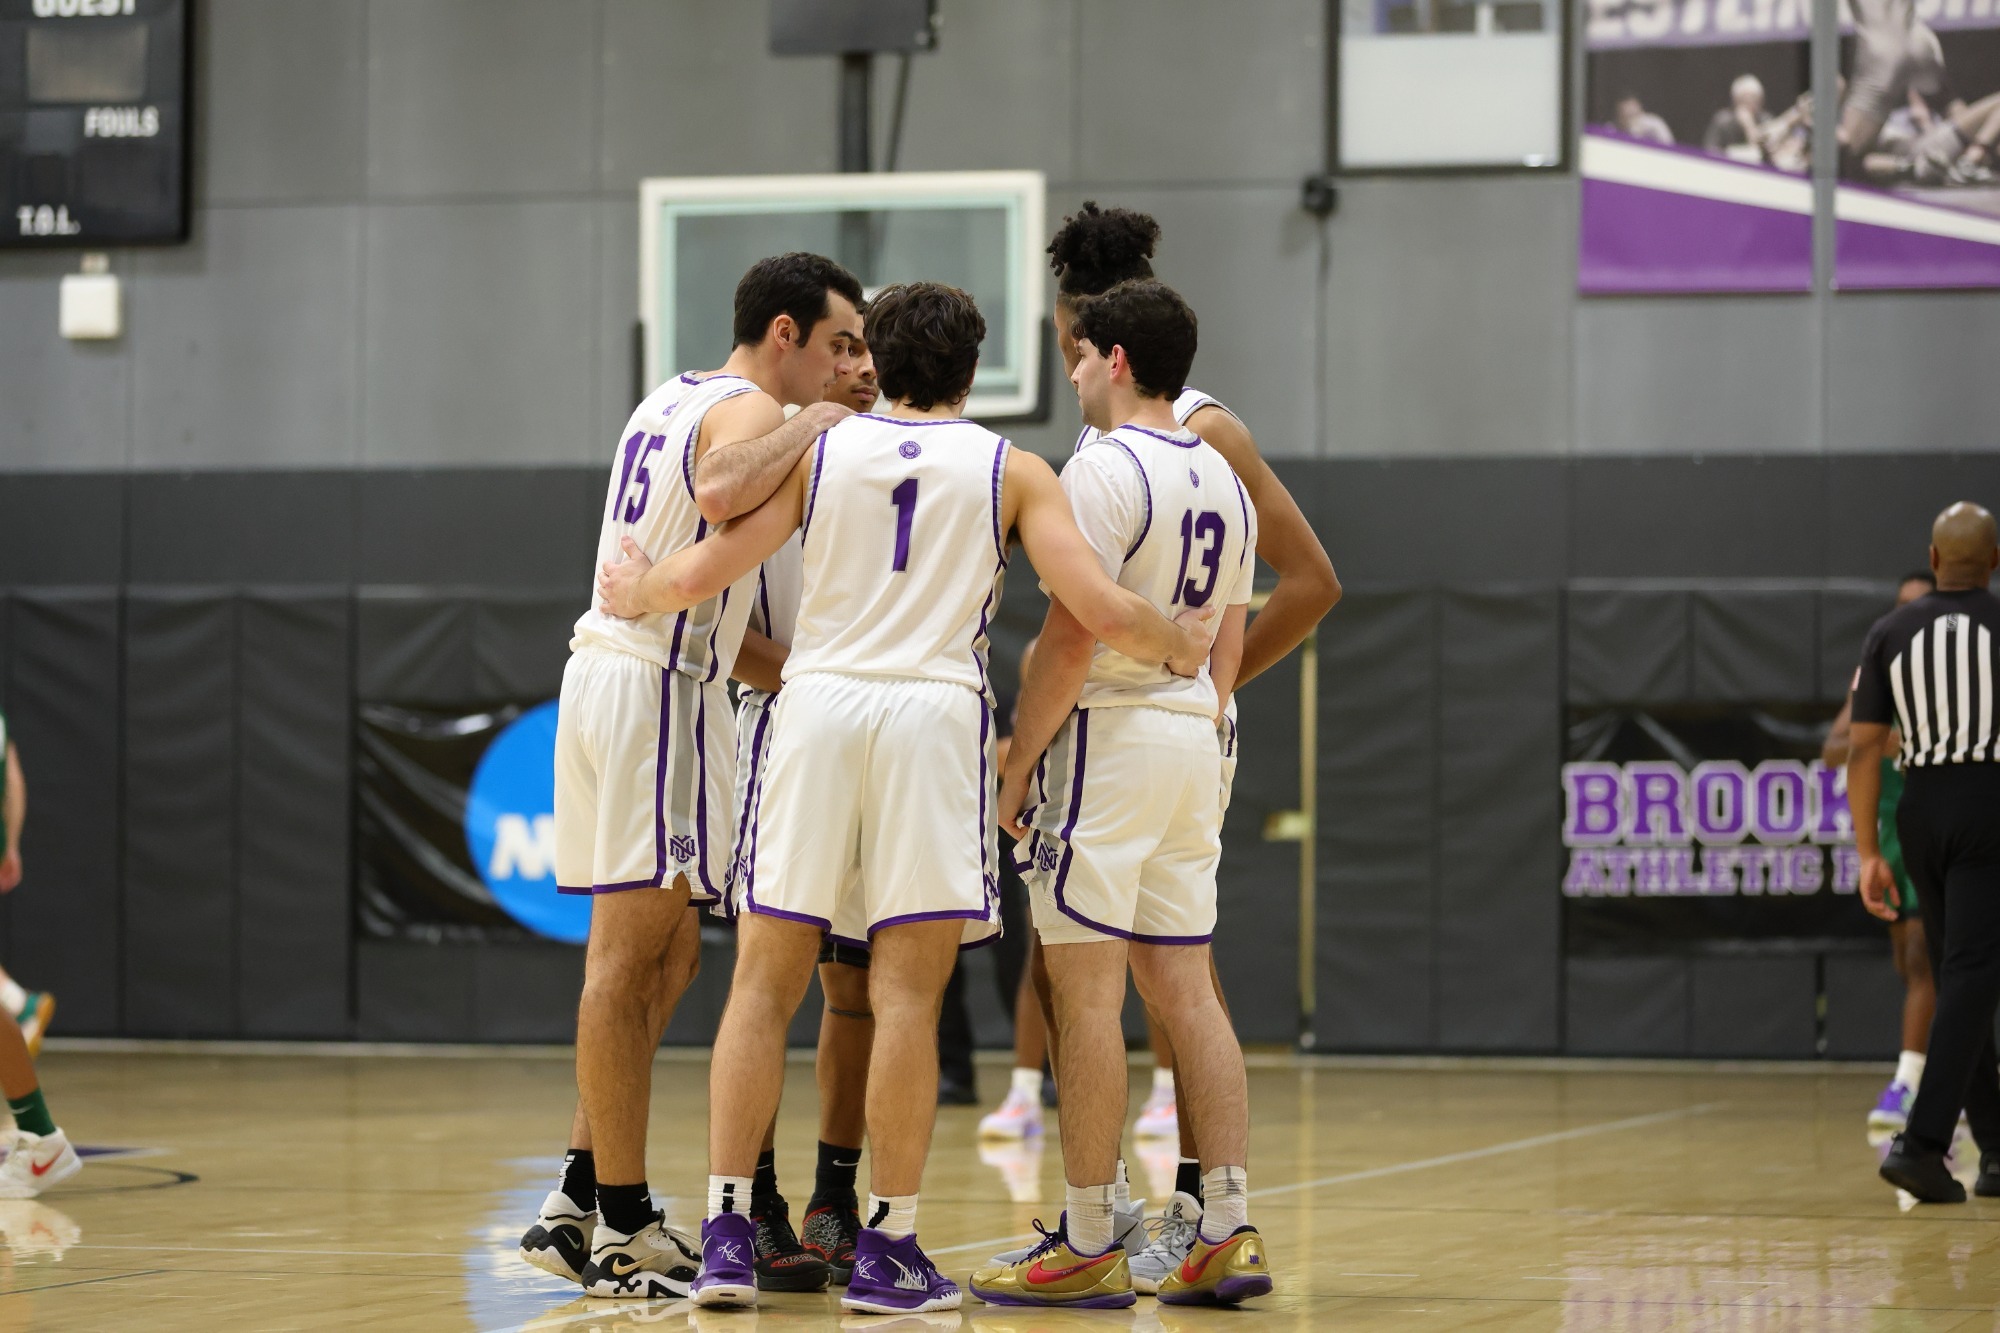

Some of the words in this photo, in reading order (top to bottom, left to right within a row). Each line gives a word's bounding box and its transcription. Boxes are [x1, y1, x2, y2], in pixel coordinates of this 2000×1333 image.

[84, 106, 159, 137] FOULS
[612, 430, 667, 525] 15
[890, 477, 920, 573] 1
[1171, 508, 1226, 608] 13
[1562, 844, 1823, 896] ATHLETIC
